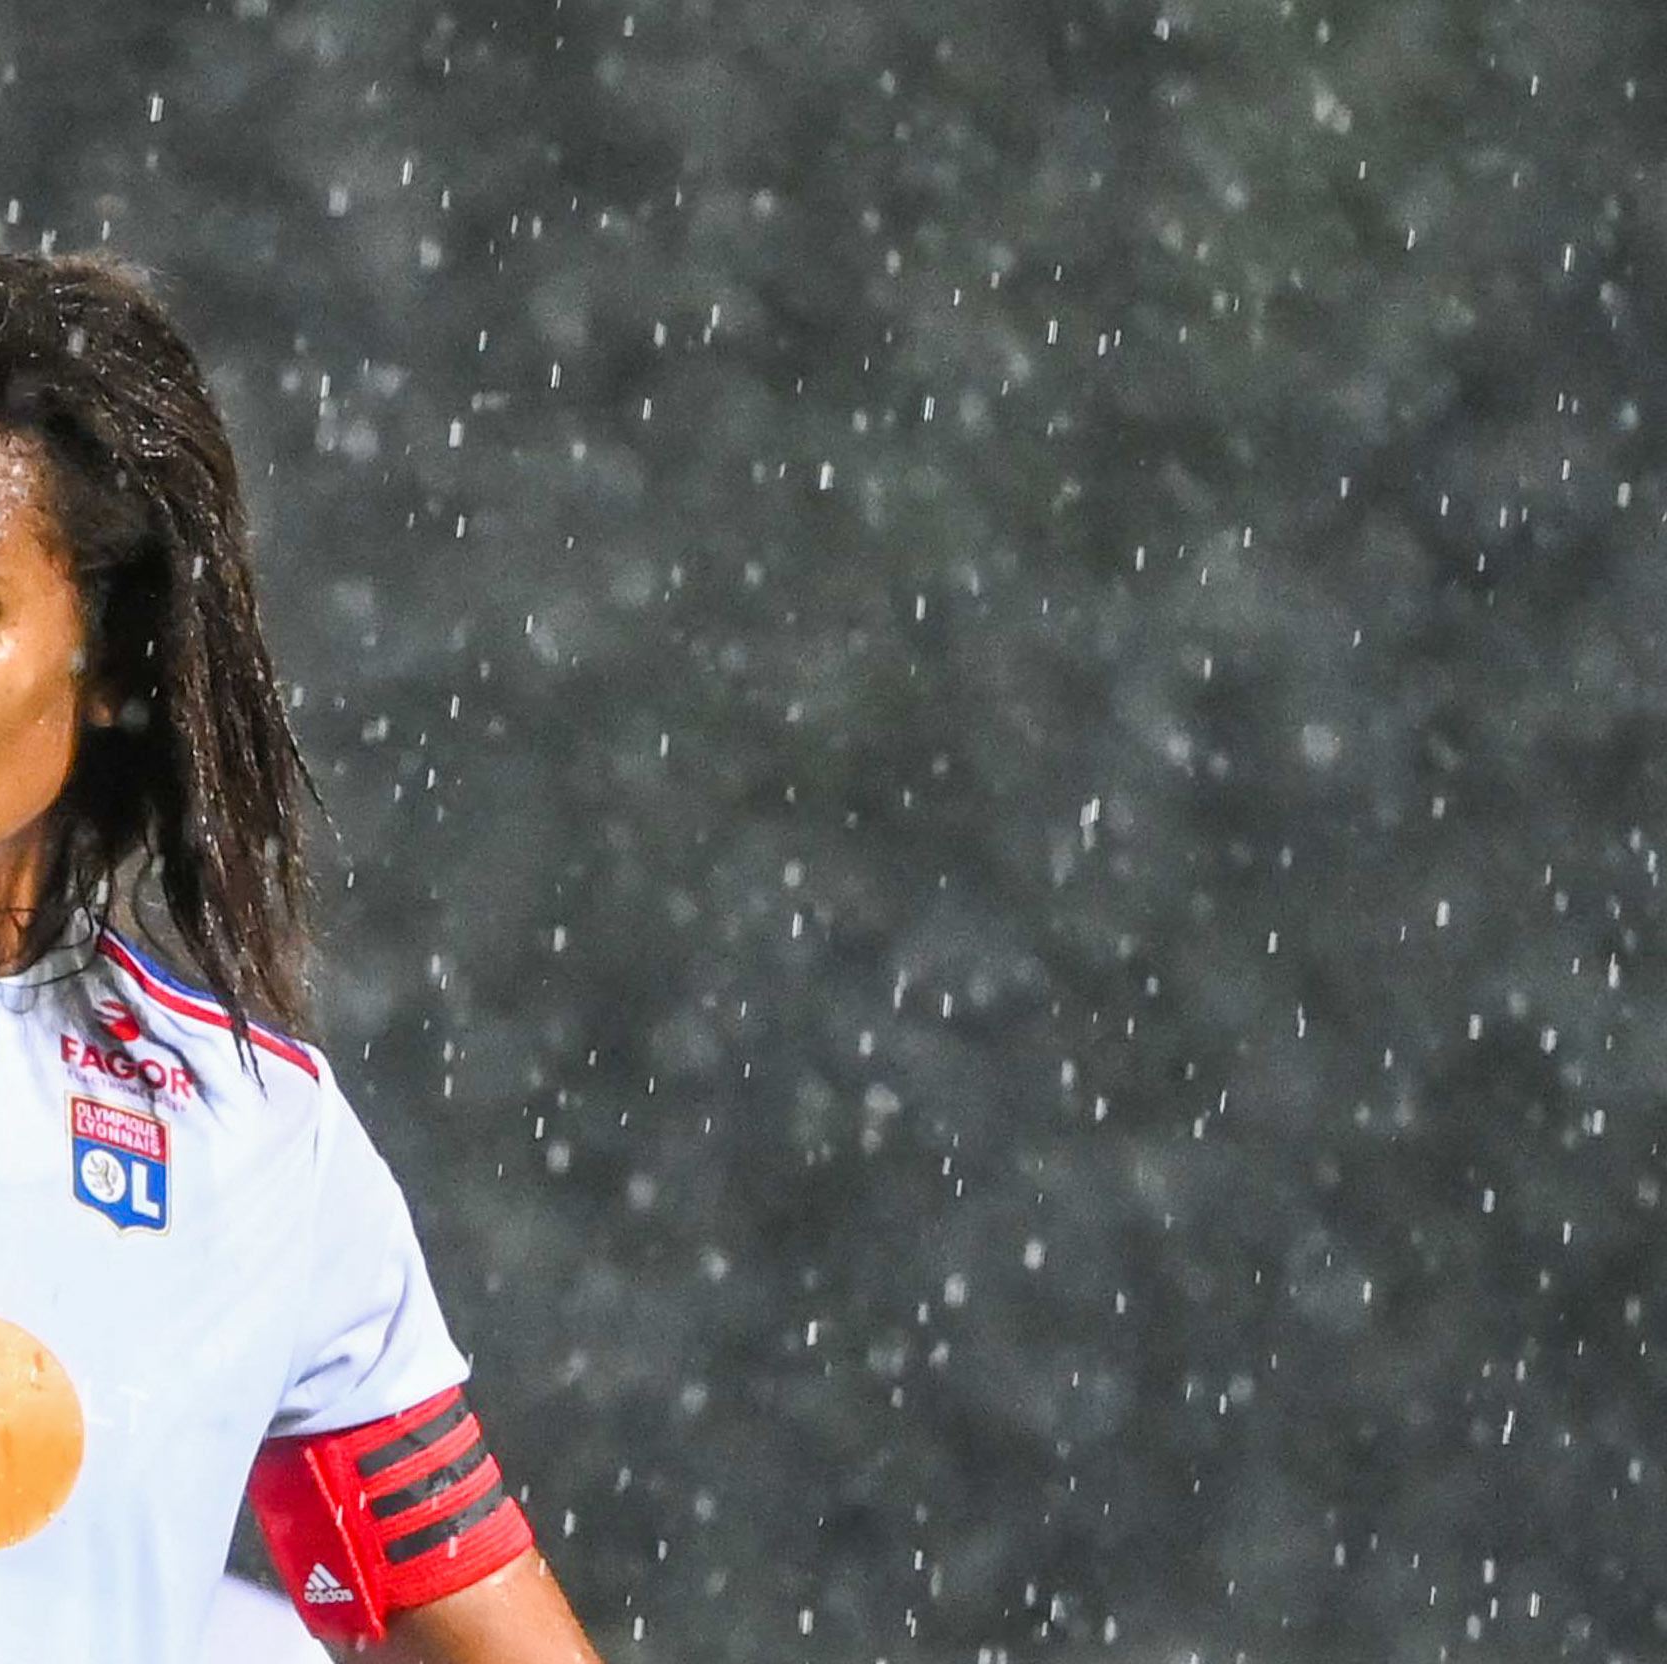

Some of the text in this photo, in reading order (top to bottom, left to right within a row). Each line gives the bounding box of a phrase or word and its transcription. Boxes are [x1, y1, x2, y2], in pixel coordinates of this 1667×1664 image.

[60, 1033, 194, 1099] FAGOR
[75, 1101, 160, 1138] OLYMPIQUE
[76, 1115, 162, 1157] LYONNAIS
[303, 1587, 355, 1604] adidas
